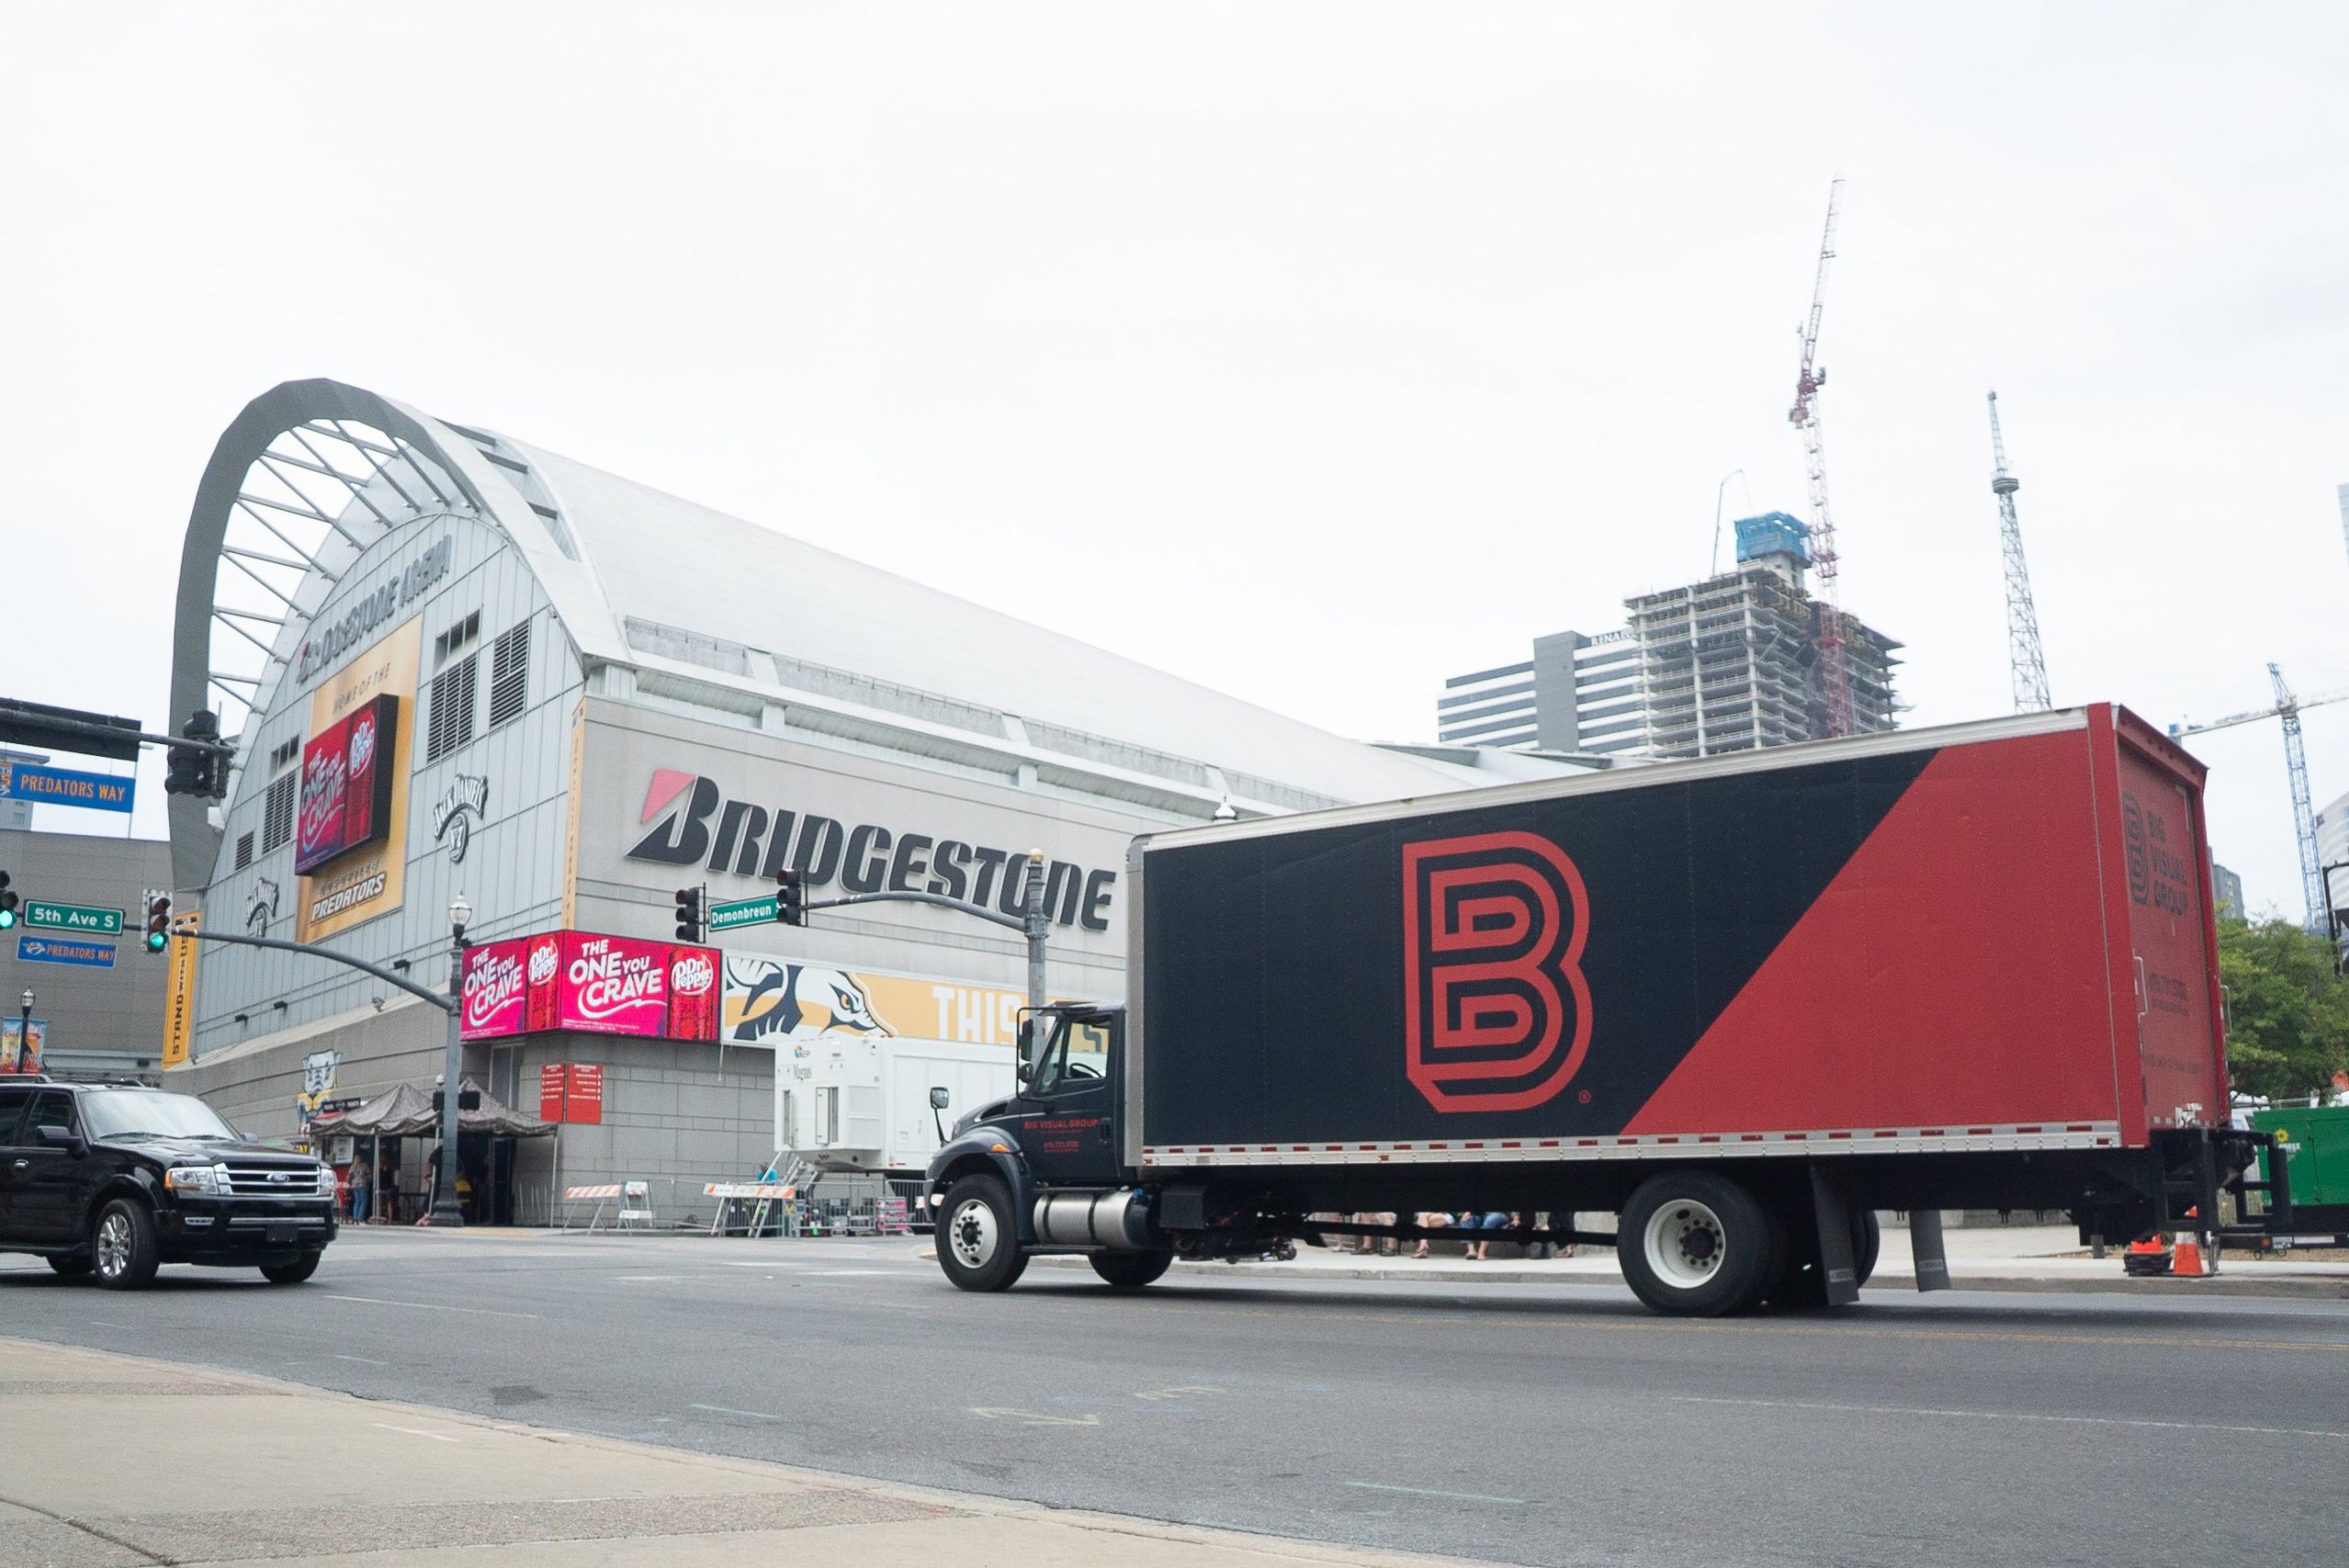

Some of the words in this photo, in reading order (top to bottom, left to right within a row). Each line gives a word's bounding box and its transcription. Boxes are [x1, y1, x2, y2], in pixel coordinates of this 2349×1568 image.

[373, 662, 391, 688] THE
[20, 773, 95, 798] PREDATORS
[98, 784, 126, 802] WAY
[625, 768, 1117, 932] BRIDGESTONE
[312, 873, 385, 922] PREDATORS
[34, 907, 61, 923] 5th
[68, 911, 98, 927] Ave
[104, 915, 115, 929] S
[712, 905, 772, 925] Demonbreun
[46, 944, 96, 960] PREDATORS
[97, 950, 117, 962] WAY
[472, 947, 490, 970] THE
[581, 939, 609, 957] THE
[464, 956, 498, 997] ONE
[496, 954, 516, 976] YOU
[569, 951, 624, 984] ONE
[622, 956, 651, 974] YOU
[674, 961, 711, 991] Pepper
[685, 958, 705, 971] Dr
[473, 964, 524, 1016] CRAVE
[586, 968, 663, 1007] CRAVE
[931, 985, 1022, 1045] THIS
[1040, 1118, 1068, 1129] VISUAL
[1068, 1118, 1098, 1128] GROUP
